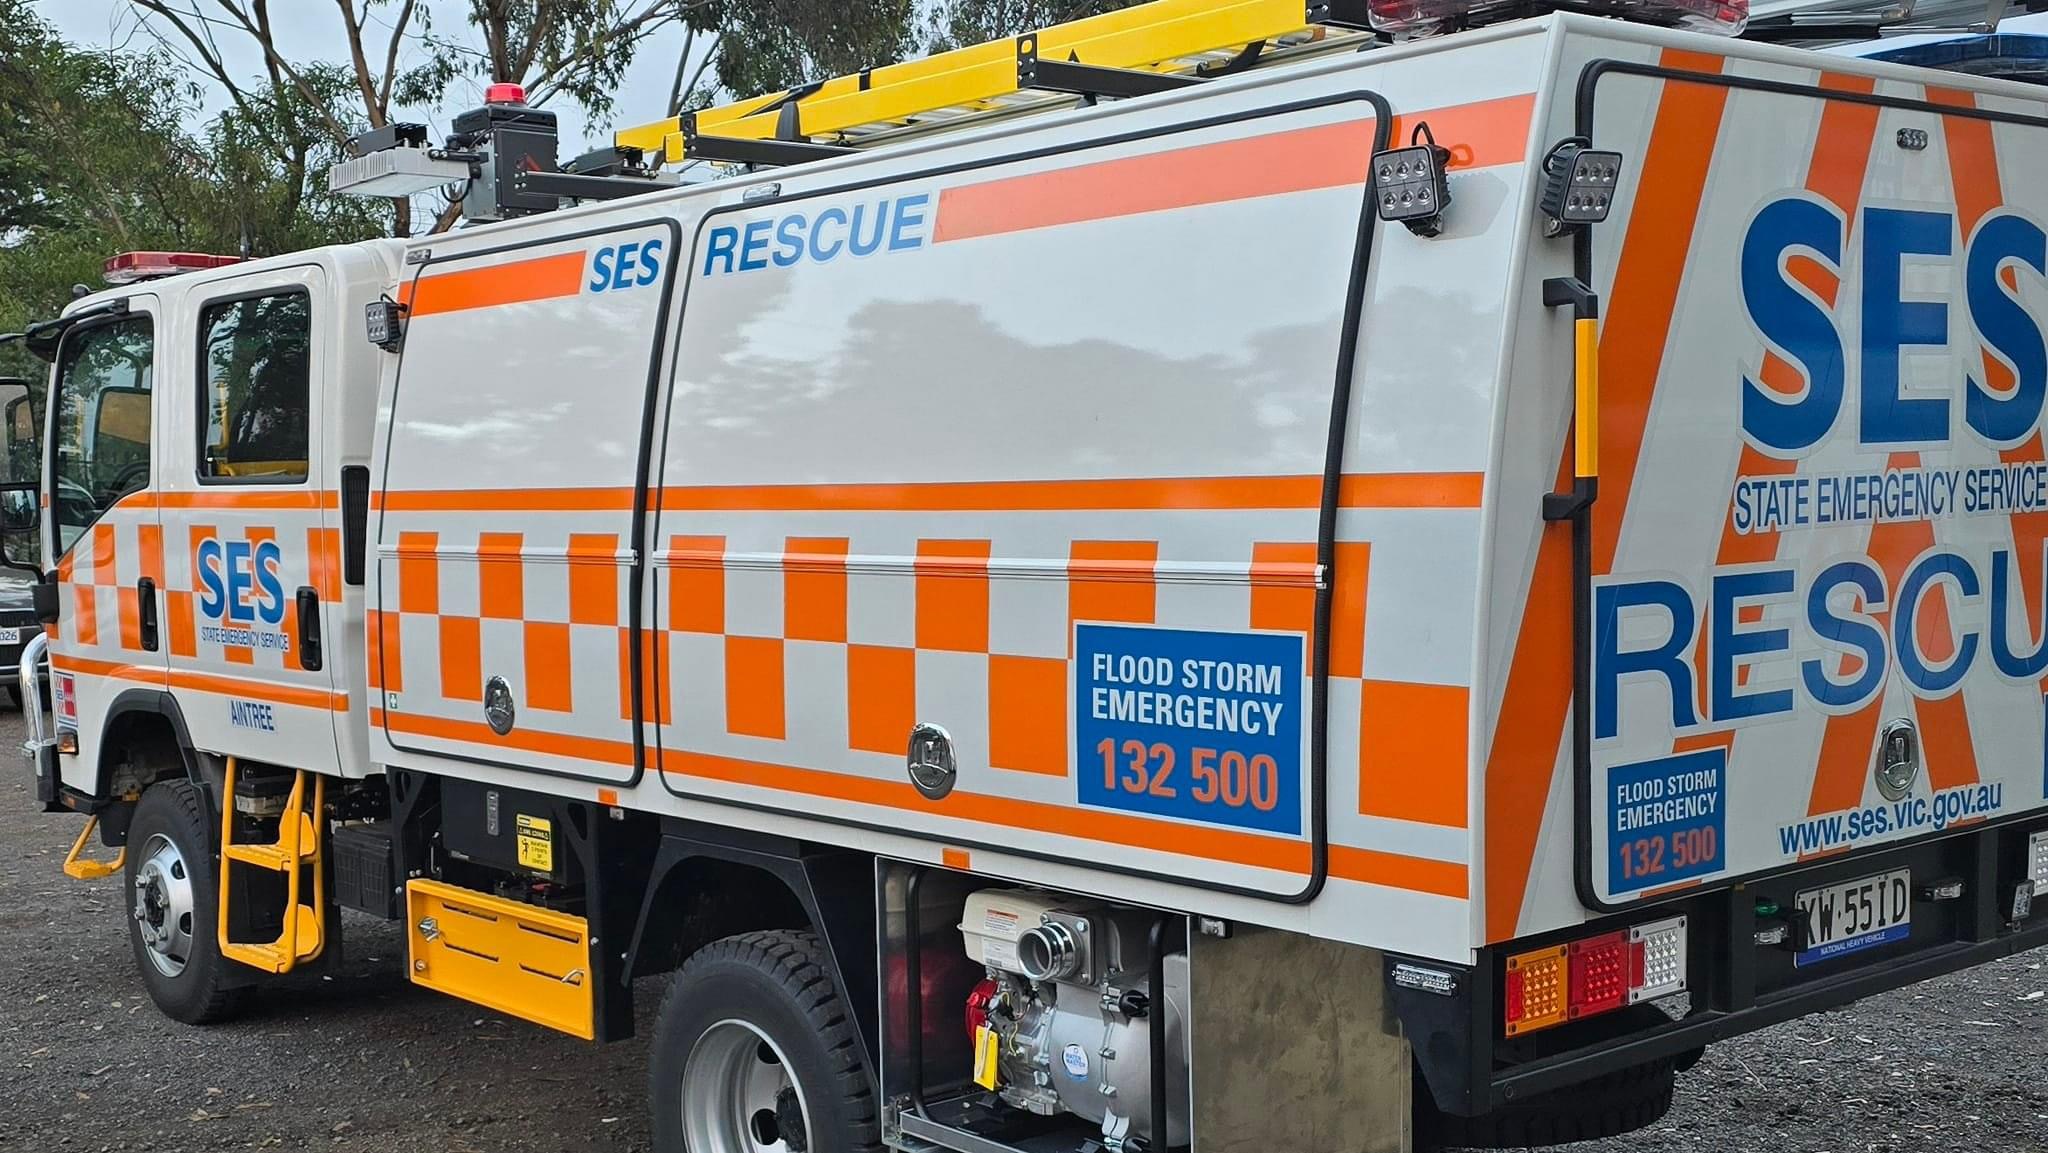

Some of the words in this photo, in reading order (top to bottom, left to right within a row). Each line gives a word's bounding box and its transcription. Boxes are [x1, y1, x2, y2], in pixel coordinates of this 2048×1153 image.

[703, 195, 928, 277] RESCUE
[590, 239, 663, 292] SES
[1741, 198, 2048, 449] SES
[1736, 478, 1809, 529] STATE
[1817, 470, 1960, 523] EMERGENCY
[1964, 465, 2047, 513] SERVICE
[199, 540, 284, 623] SES
[201, 626, 220, 642] STATE
[1093, 653, 1173, 686] FLOOD
[1182, 659, 1282, 695] STORM
[230, 700, 275, 731] AINTREE
[1092, 687, 1283, 736] EMERGENCY
[1097, 738, 1177, 797] 132
[1191, 747, 1279, 811] 500
[1617, 778, 1664, 805] FLOOD
[1667, 768, 1717, 796] STORM
[1617, 791, 1718, 832] EMERGENCY
[1779, 783, 2002, 854] www.ses.vic.gov.au
[1620, 836, 1665, 879] 132
[1671, 825, 1717, 868] 500
